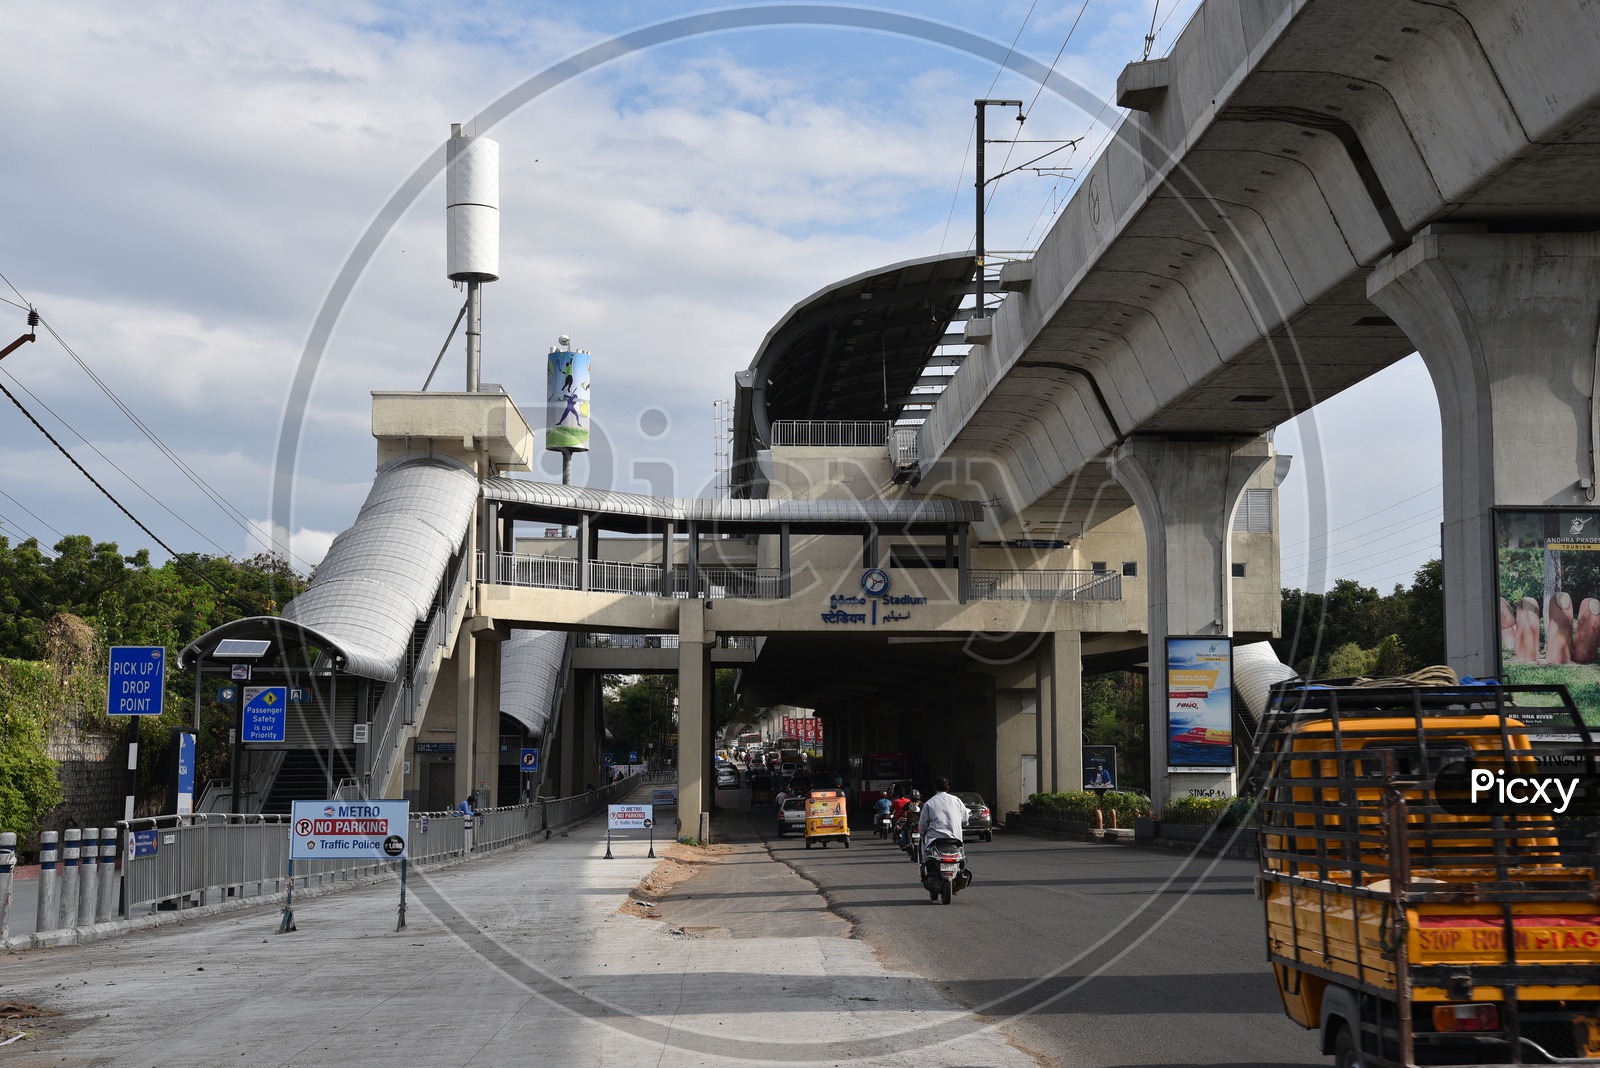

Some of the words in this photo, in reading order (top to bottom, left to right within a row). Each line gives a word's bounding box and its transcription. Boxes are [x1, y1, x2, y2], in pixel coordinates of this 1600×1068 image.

[882, 594, 927, 605] Stadium
[821, 610, 866, 624] स्टेडियम
[113, 662, 137, 675] PICK
[140, 662, 154, 675] UP
[122, 681, 150, 694] DROP
[120, 698, 151, 711] POINT
[247, 706, 282, 714] Passenger
[338, 806, 380, 817] METRO
[315, 821, 332, 833] NO
[336, 821, 387, 833] PARKING
[320, 839, 350, 849] Traffic
[352, 839, 381, 849] Police
[1419, 930, 1461, 950] STOP
